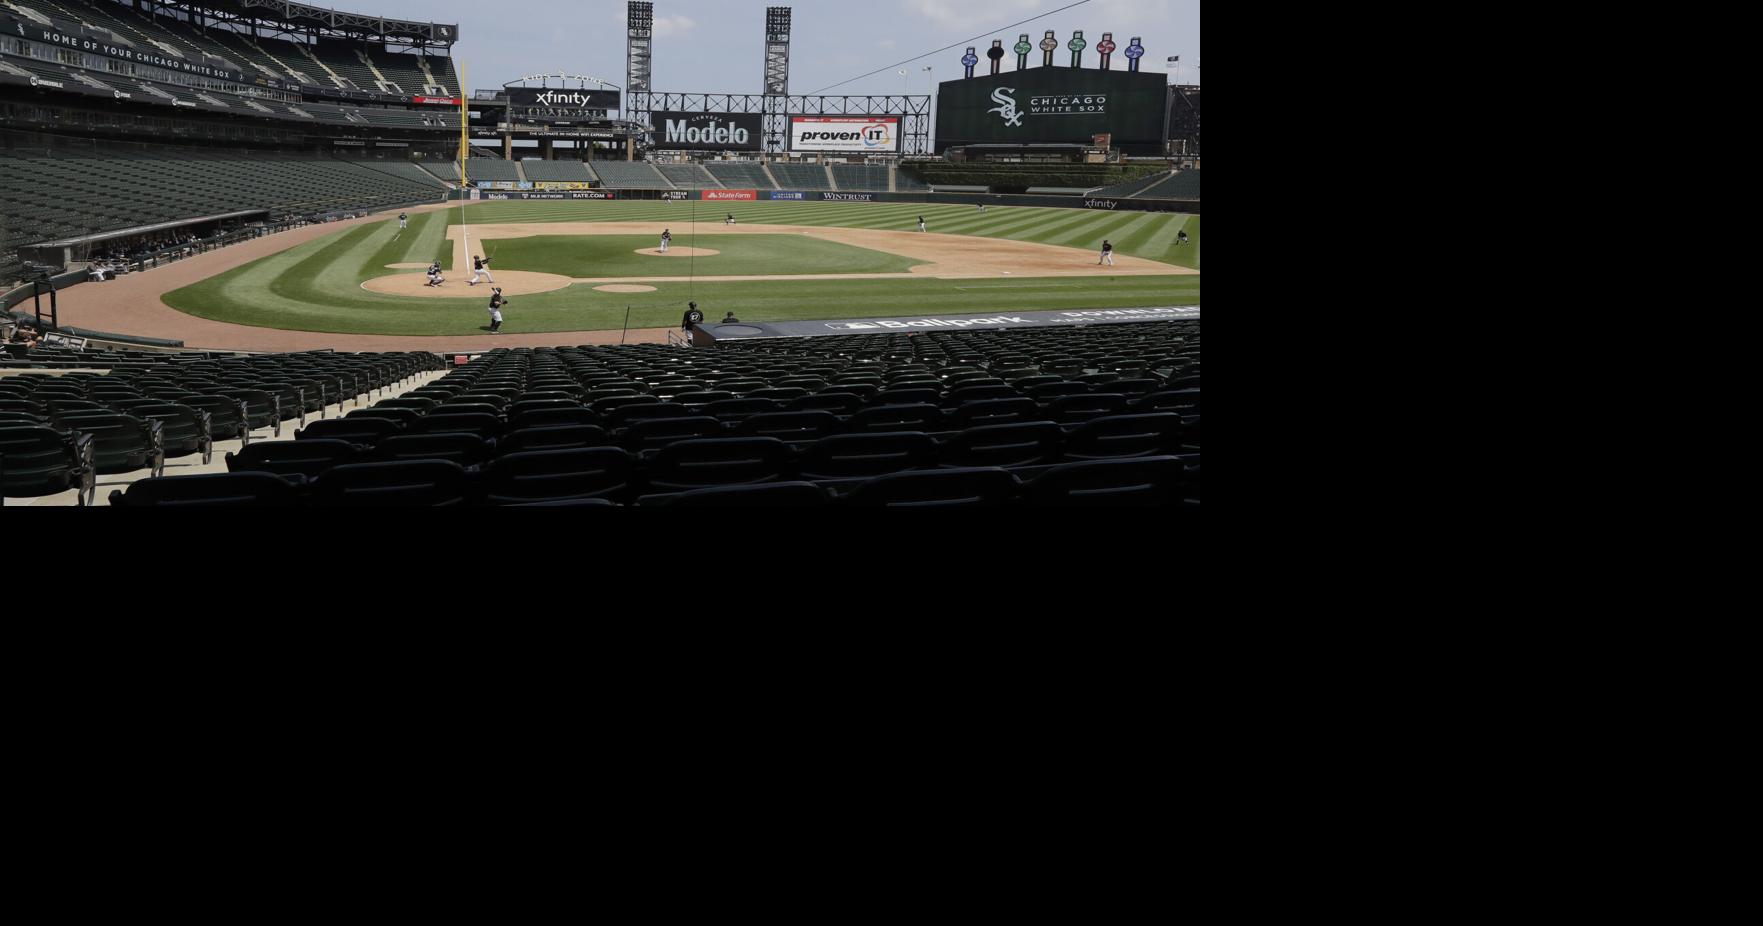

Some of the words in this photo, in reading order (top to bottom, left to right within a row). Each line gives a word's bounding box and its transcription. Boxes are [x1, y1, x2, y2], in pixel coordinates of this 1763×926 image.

[43, 31, 77, 46] HOME
[83, 41, 98, 50] OF
[103, 45, 132, 58] YOUR
[136, 53, 180, 68] CHICAGO
[183, 63, 211, 75] WHITE
[214, 69, 230, 78] SOX
[536, 90, 591, 107] xfinity
[1030, 97, 1106, 105] CHICAGO
[691, 115, 723, 123] CERVEZA
[665, 119, 749, 144] Modelo
[800, 131, 861, 142] proven
[868, 130, 883, 141] IT
[823, 192, 872, 200] WINTRUST
[1085, 198, 1118, 210] xfinity
[875, 315, 1034, 328] Ballpark
